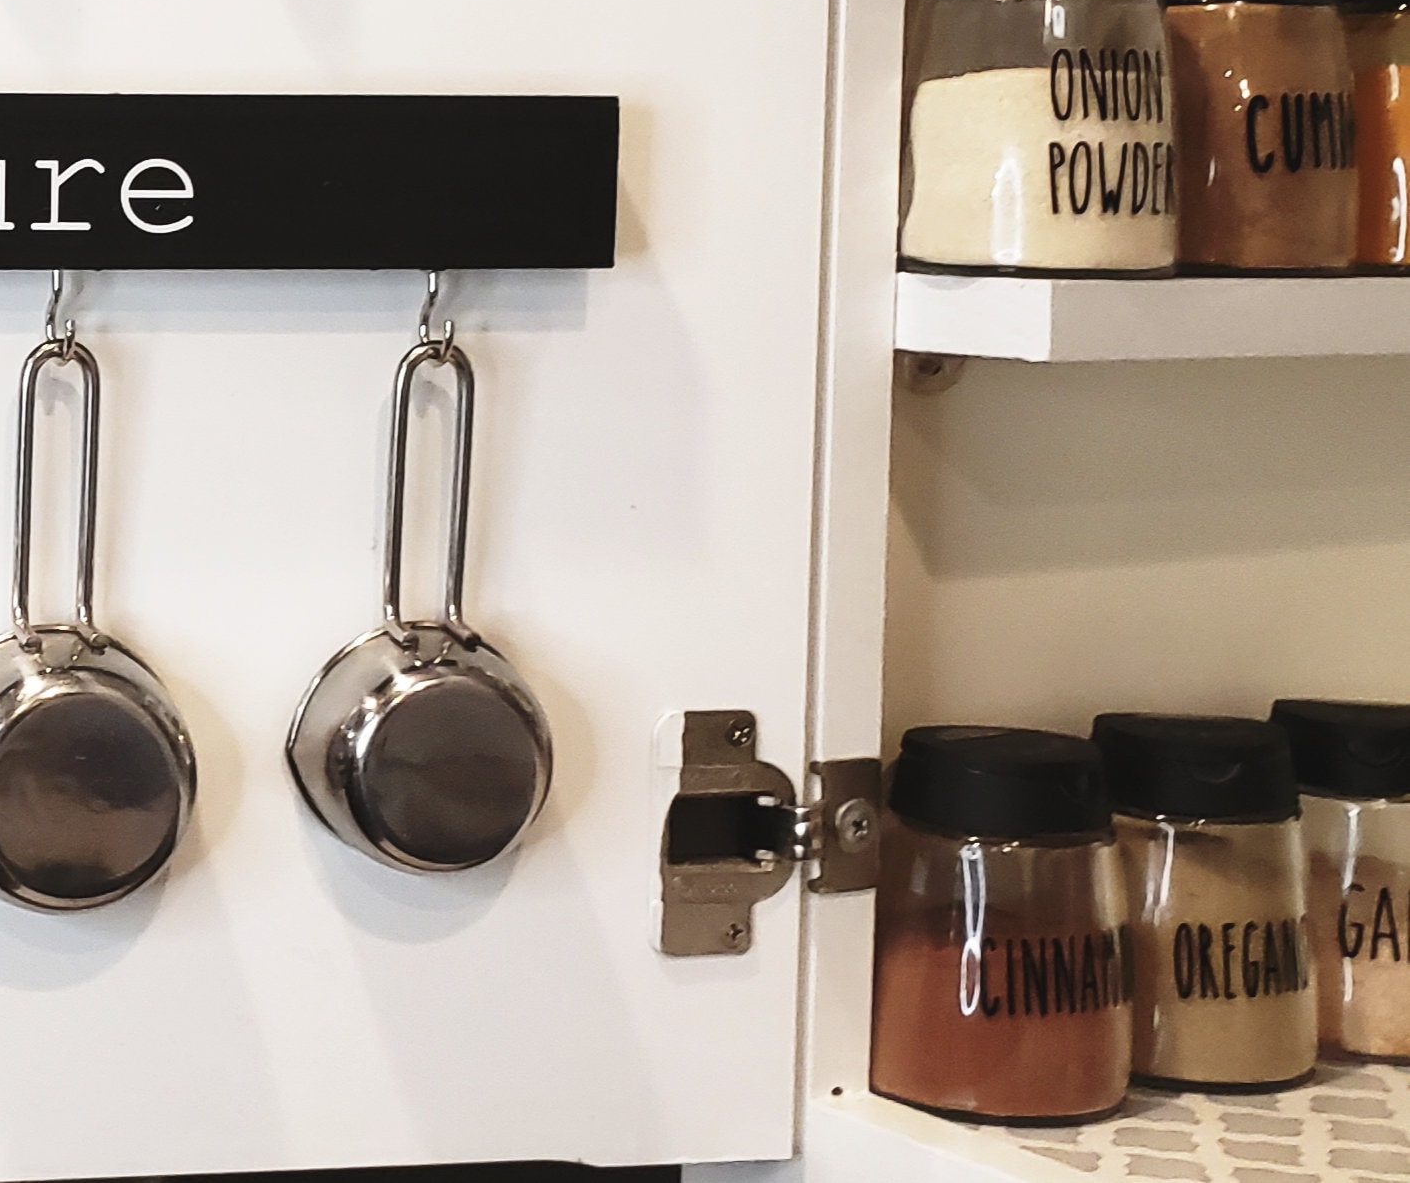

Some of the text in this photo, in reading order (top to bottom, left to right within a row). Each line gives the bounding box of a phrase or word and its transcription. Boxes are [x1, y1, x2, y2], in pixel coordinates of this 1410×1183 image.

[1050, 48, 1165, 123] ONION
[1173, 915, 1308, 1000] OREGAN
[1338, 882, 1410, 963] GA
